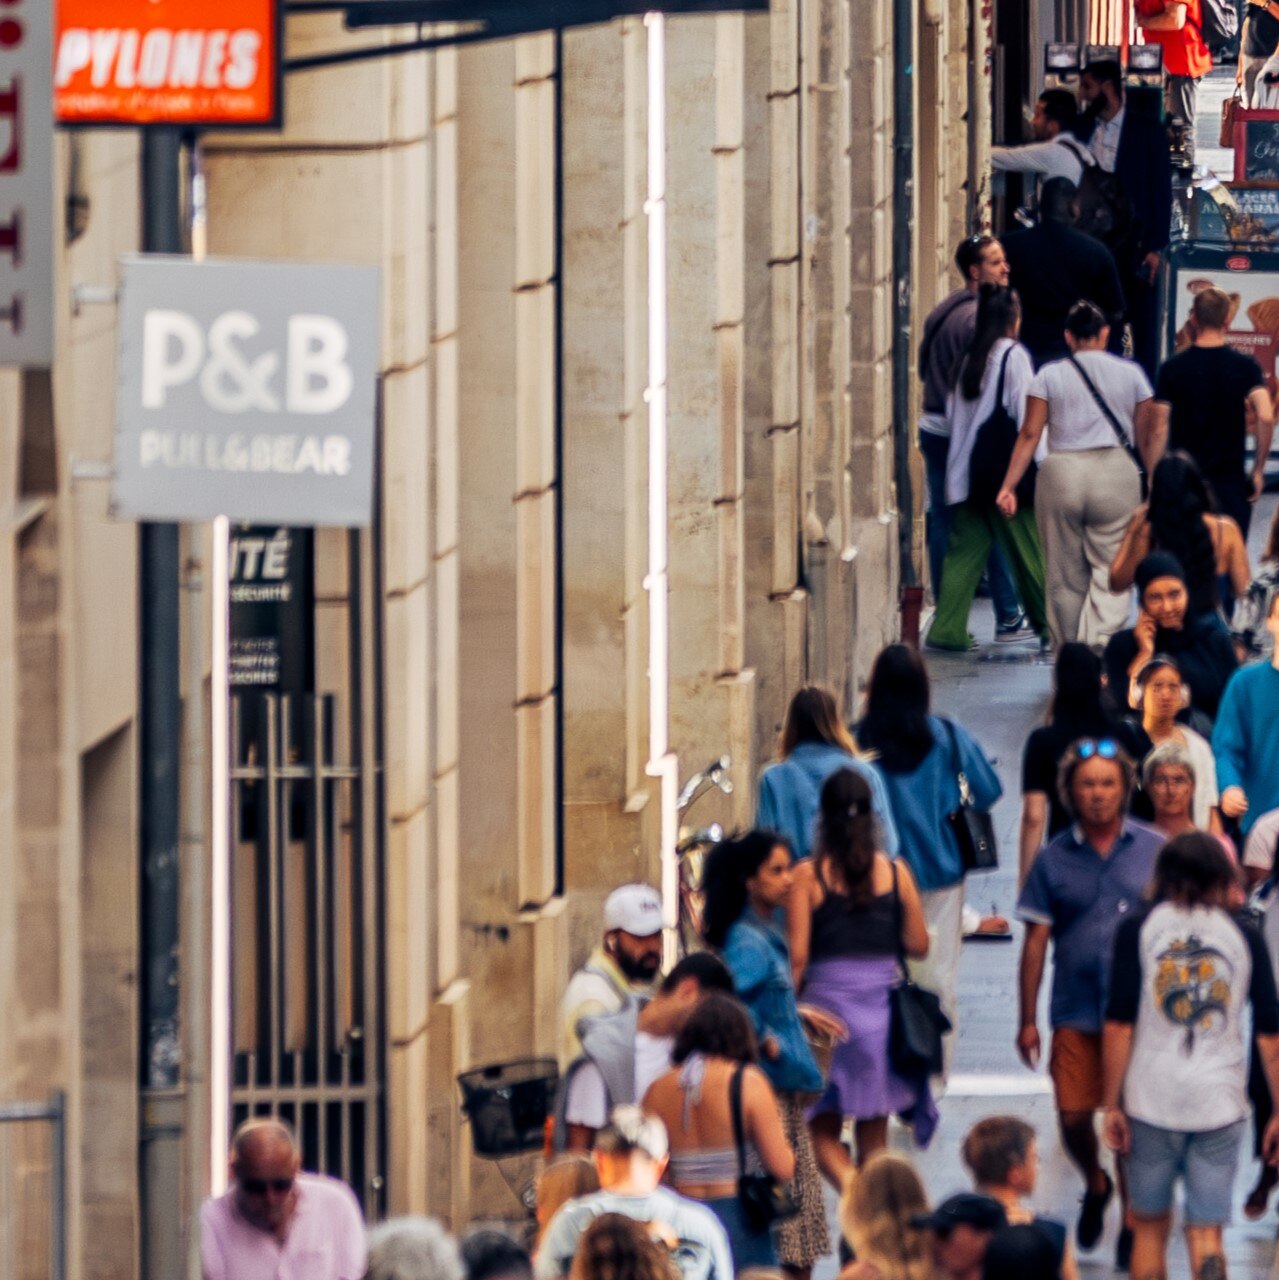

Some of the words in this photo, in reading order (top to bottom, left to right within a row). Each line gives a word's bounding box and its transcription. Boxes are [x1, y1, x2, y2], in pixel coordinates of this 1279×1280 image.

[54, 28, 261, 89] PYLONES
[141, 308, 355, 415] P&B
[139, 429, 352, 477] PULL&BEAR
